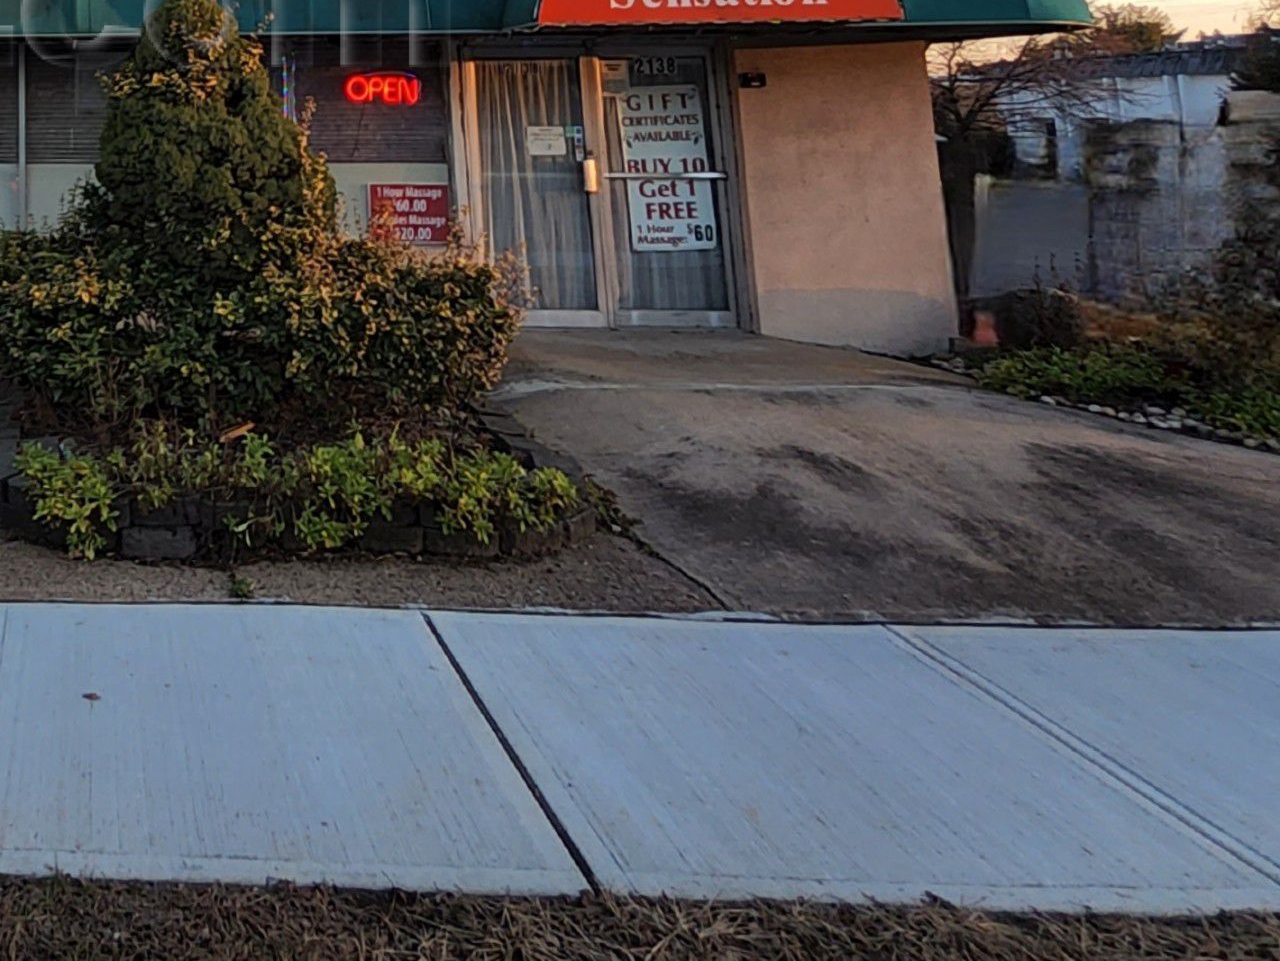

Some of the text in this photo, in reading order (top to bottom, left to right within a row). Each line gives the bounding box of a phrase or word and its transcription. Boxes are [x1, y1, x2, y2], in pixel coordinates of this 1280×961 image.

[635, 57, 677, 75] 2138
[345, 74, 419, 105] OPEN
[626, 92, 689, 111] GIFT
[622, 114, 699, 127] CERTIFICATES
[632, 130, 691, 143] AVAILABLE
[627, 158, 705, 173] BUY 10
[377, 187, 442, 200] 1 Hour Massage
[639, 179, 696, 198] Get 1
[645, 201, 699, 220] FREE
[408, 215, 446, 228] Massage
[637, 225, 643, 233] 1
[647, 224, 675, 233] Hour
